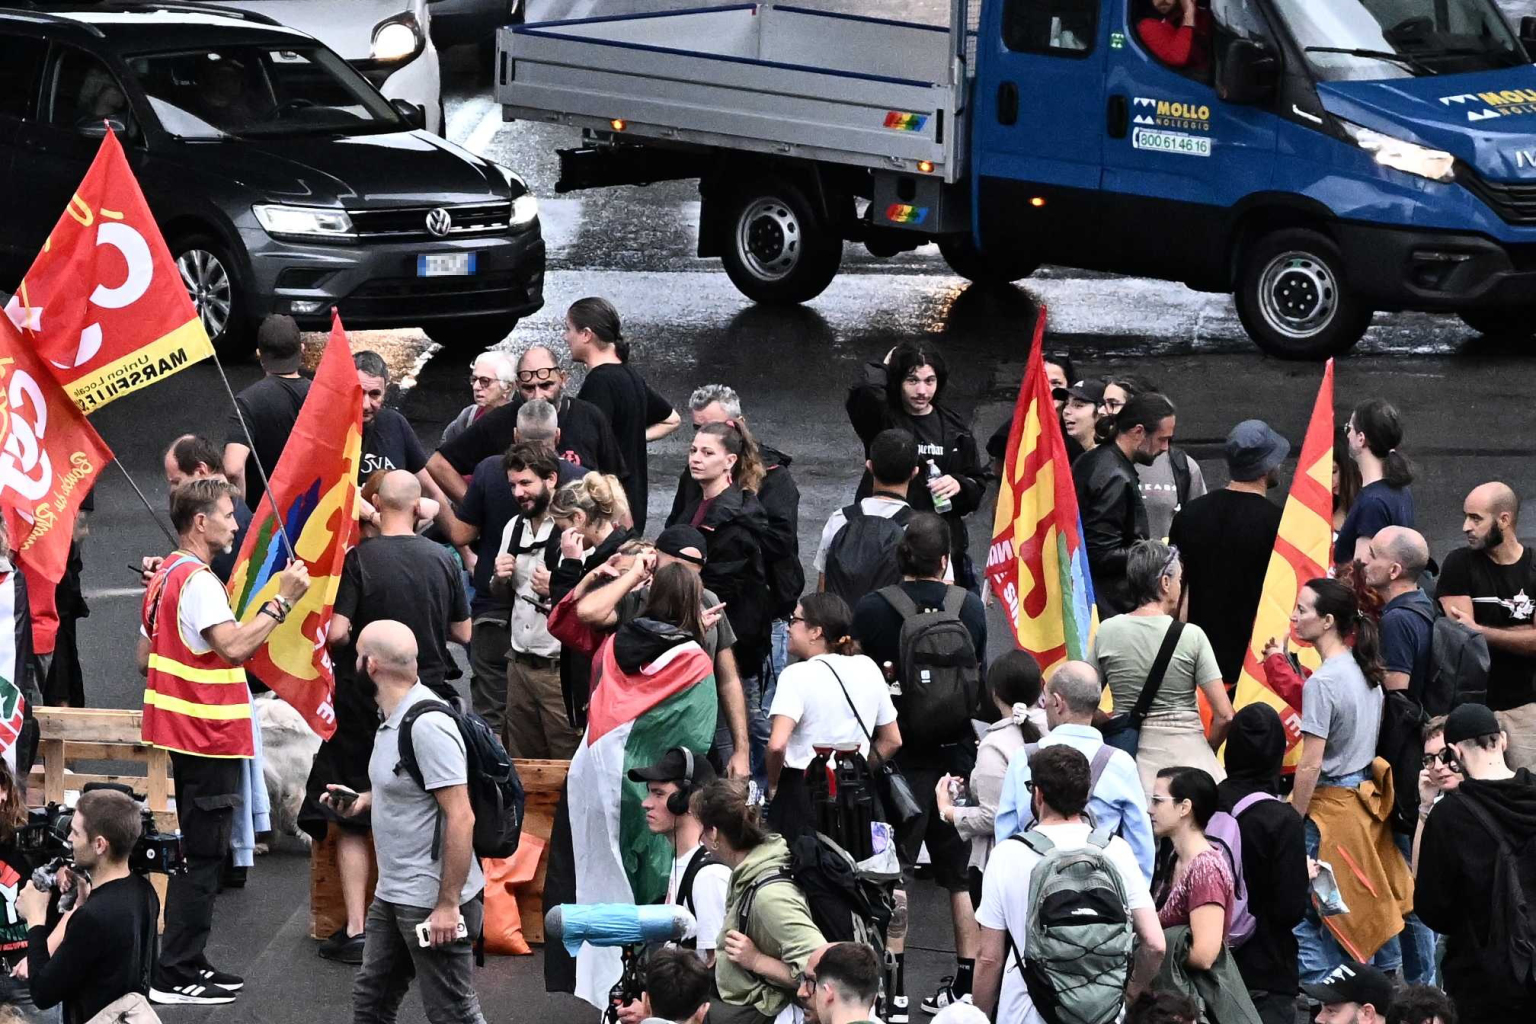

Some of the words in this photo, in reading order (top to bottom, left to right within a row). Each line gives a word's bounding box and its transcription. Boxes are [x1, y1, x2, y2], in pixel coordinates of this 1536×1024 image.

[1156, 100, 1210, 120] MOLLO
[1155, 118, 1210, 131] NOLEGGIO
[1141, 133, 1162, 147] 800
